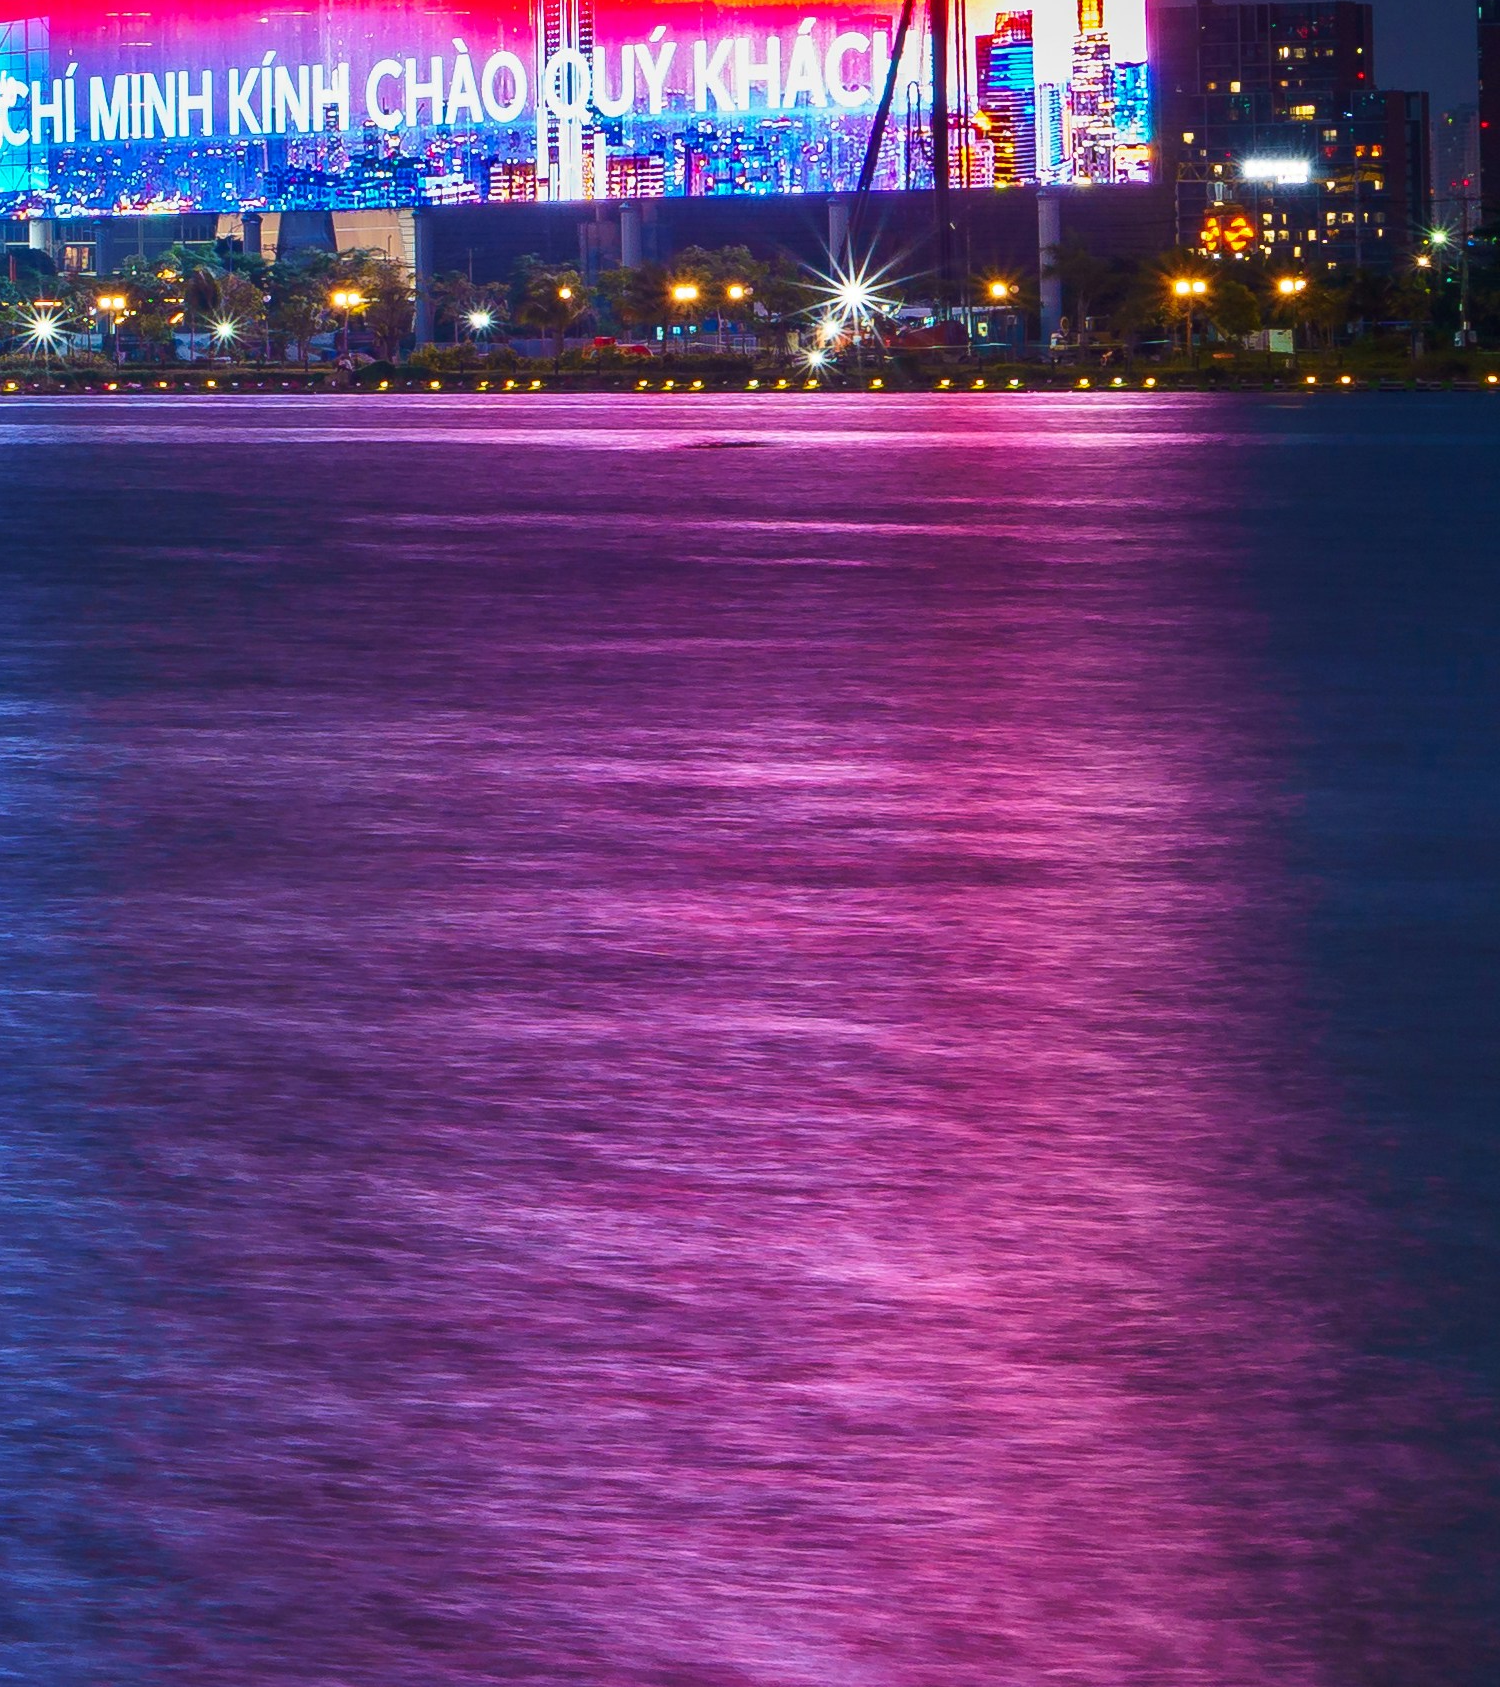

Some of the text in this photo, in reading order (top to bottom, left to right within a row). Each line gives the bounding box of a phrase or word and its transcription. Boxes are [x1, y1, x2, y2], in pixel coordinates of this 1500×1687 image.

[3, 62, 76, 146] CHÍ
[90, 69, 213, 141] MINH
[228, 50, 351, 136] KÍNH
[364, 37, 528, 130] CHÀO
[544, 25, 677, 126] QUÝ
